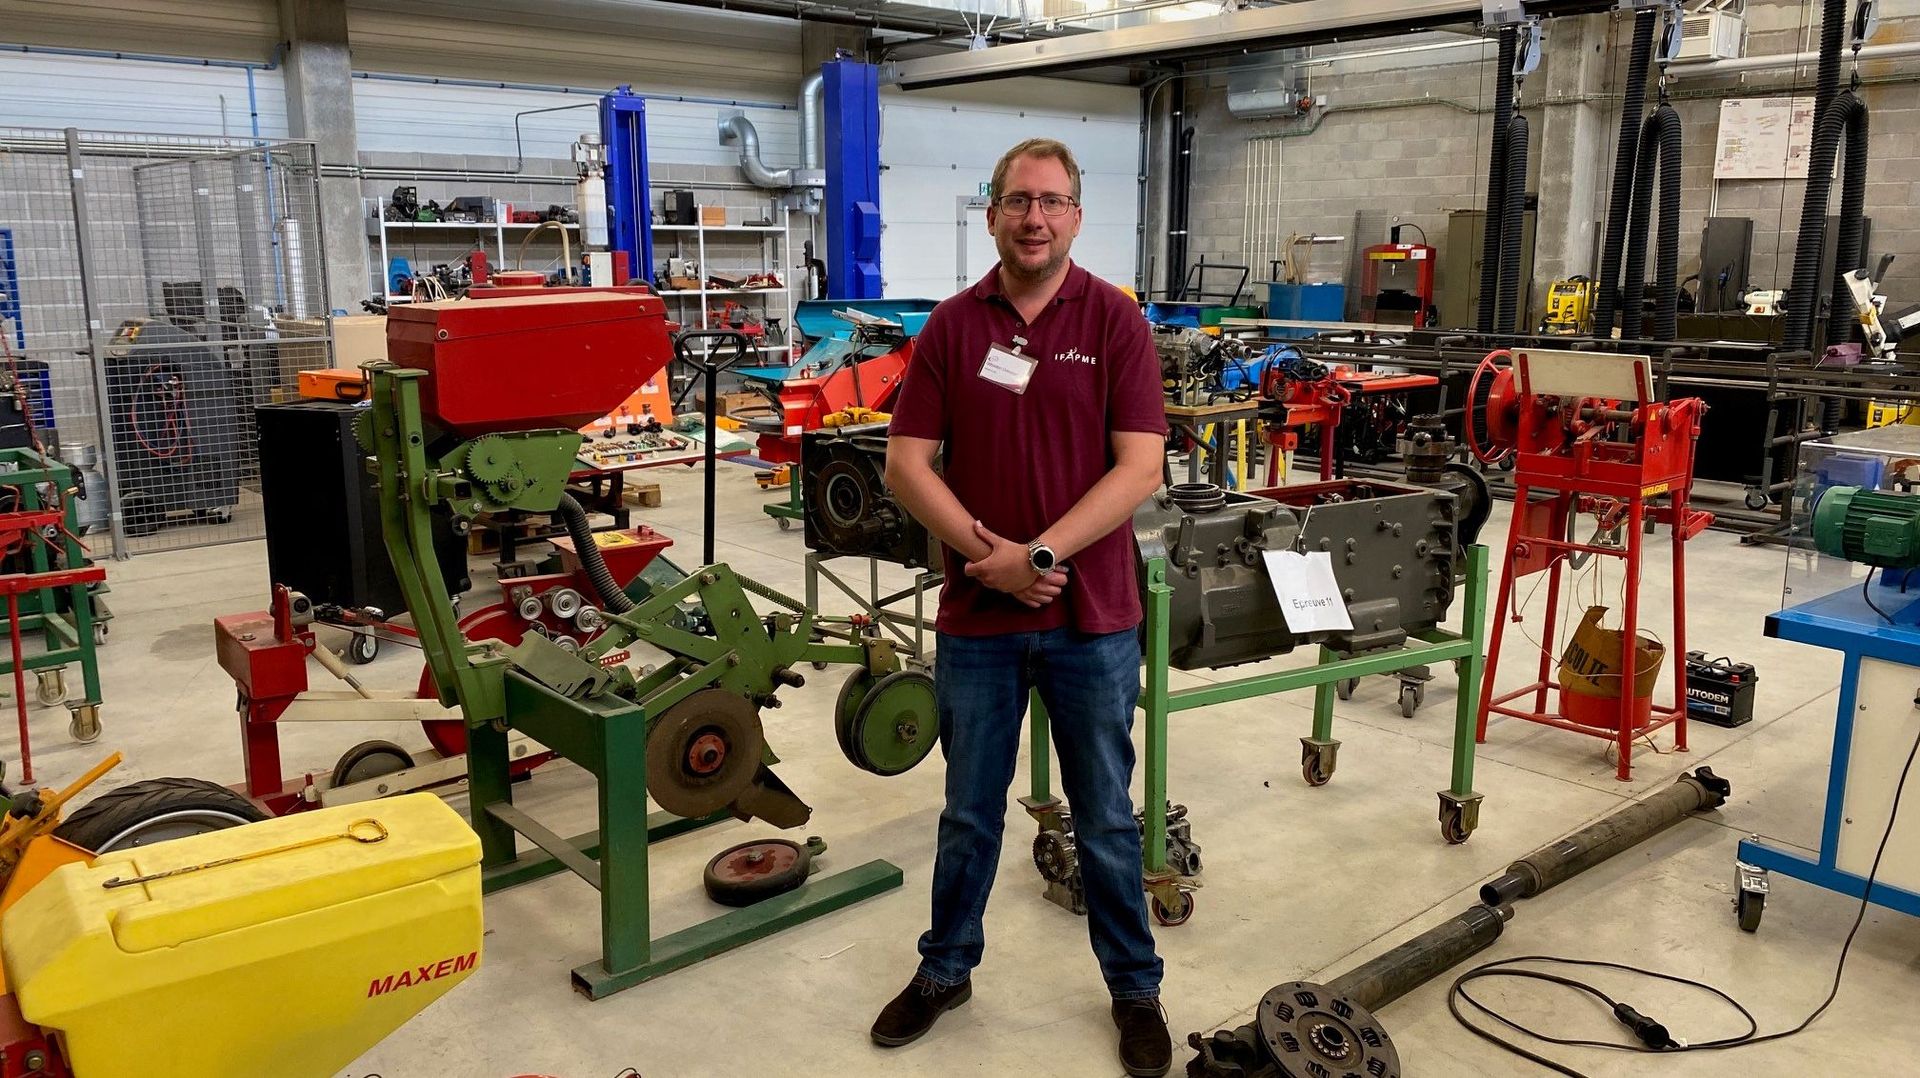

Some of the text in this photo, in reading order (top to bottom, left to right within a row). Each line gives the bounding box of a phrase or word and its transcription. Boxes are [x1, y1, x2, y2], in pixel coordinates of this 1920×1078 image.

[1055, 347, 1097, 365] IFAPME
[1292, 598, 1325, 611] Epreuve
[1686, 687, 1729, 704] UTODEM
[368, 951, 478, 998] MAXEM
